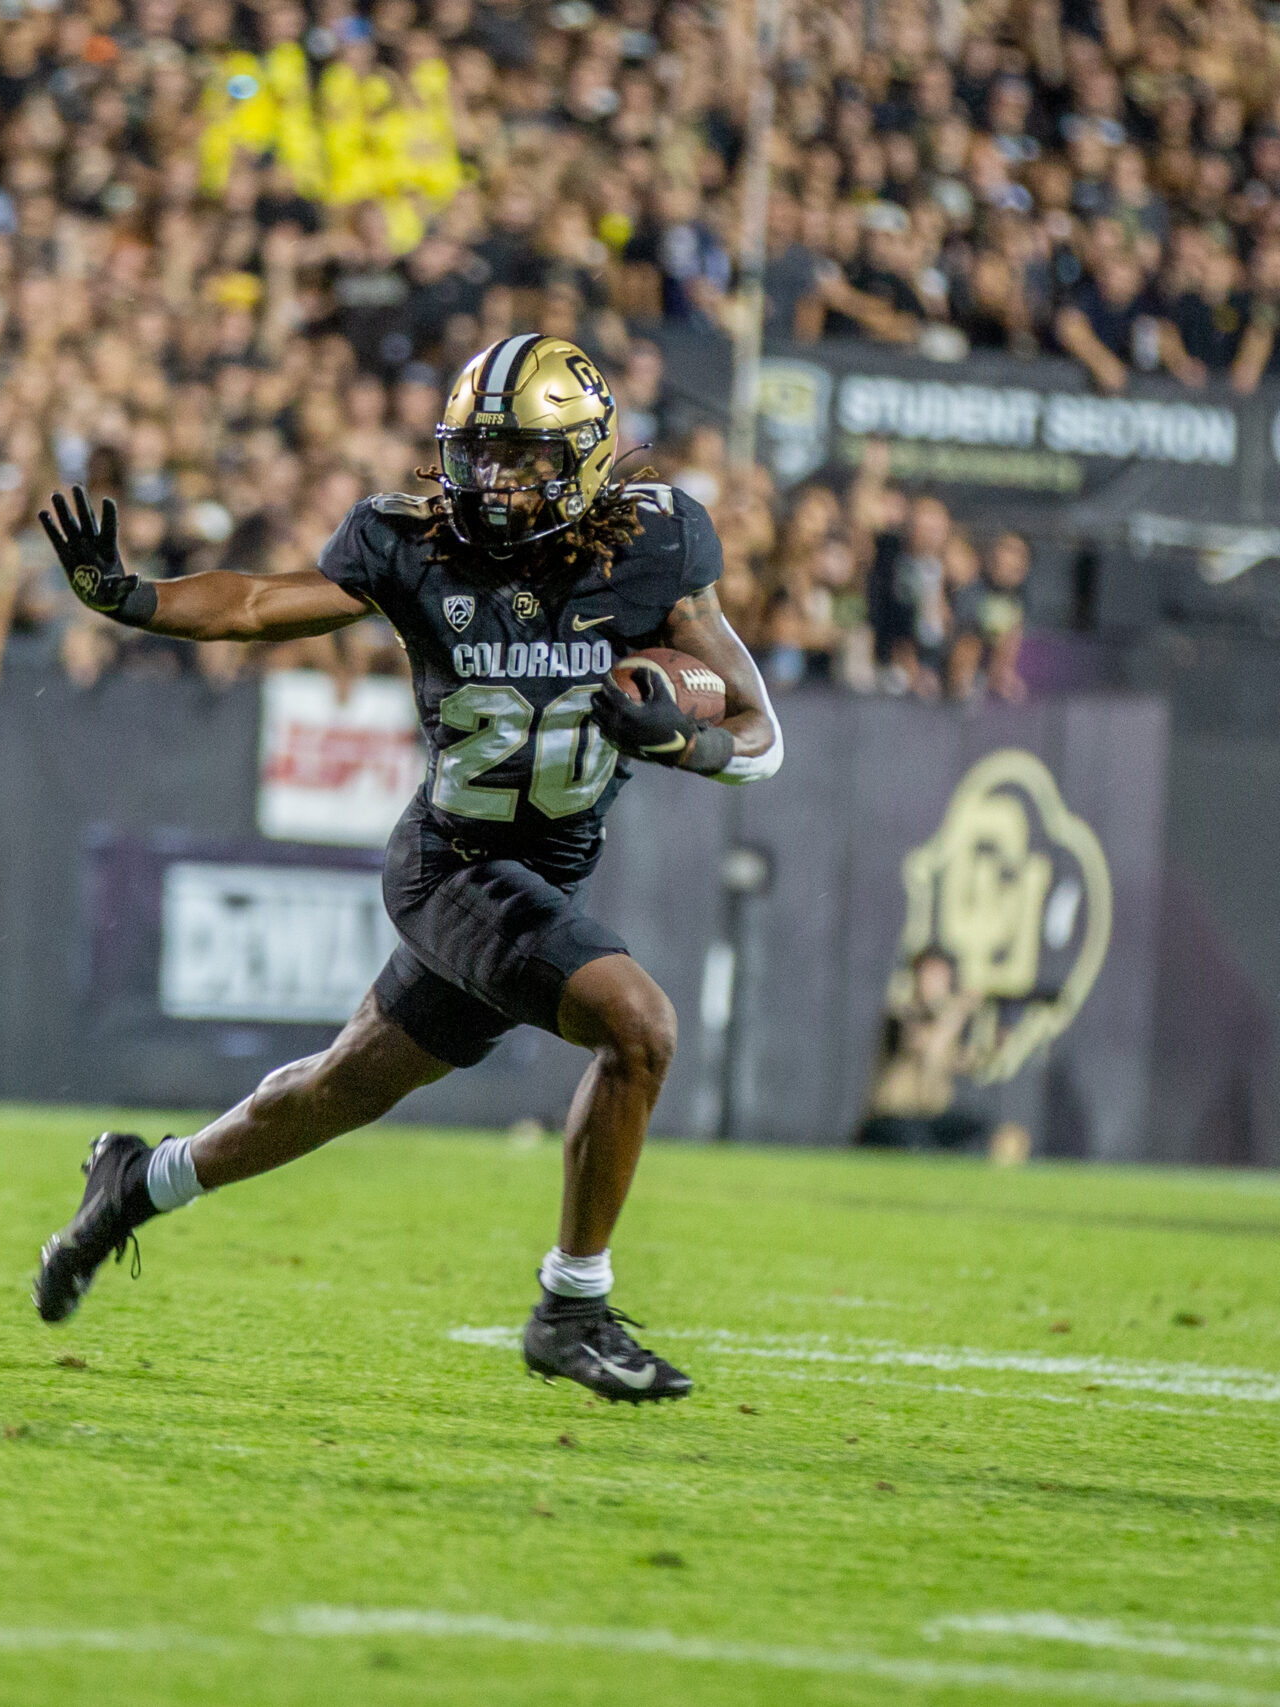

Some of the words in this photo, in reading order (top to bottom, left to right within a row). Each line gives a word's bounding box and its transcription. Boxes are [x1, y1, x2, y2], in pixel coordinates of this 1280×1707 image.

[474, 412, 505, 425] BUFFS
[838, 374, 1039, 447] STUDENT
[1043, 391, 1238, 466] SECTION
[451, 610, 468, 625] 12
[453, 639, 612, 678] COLORADO
[432, 684, 618, 822] 20
